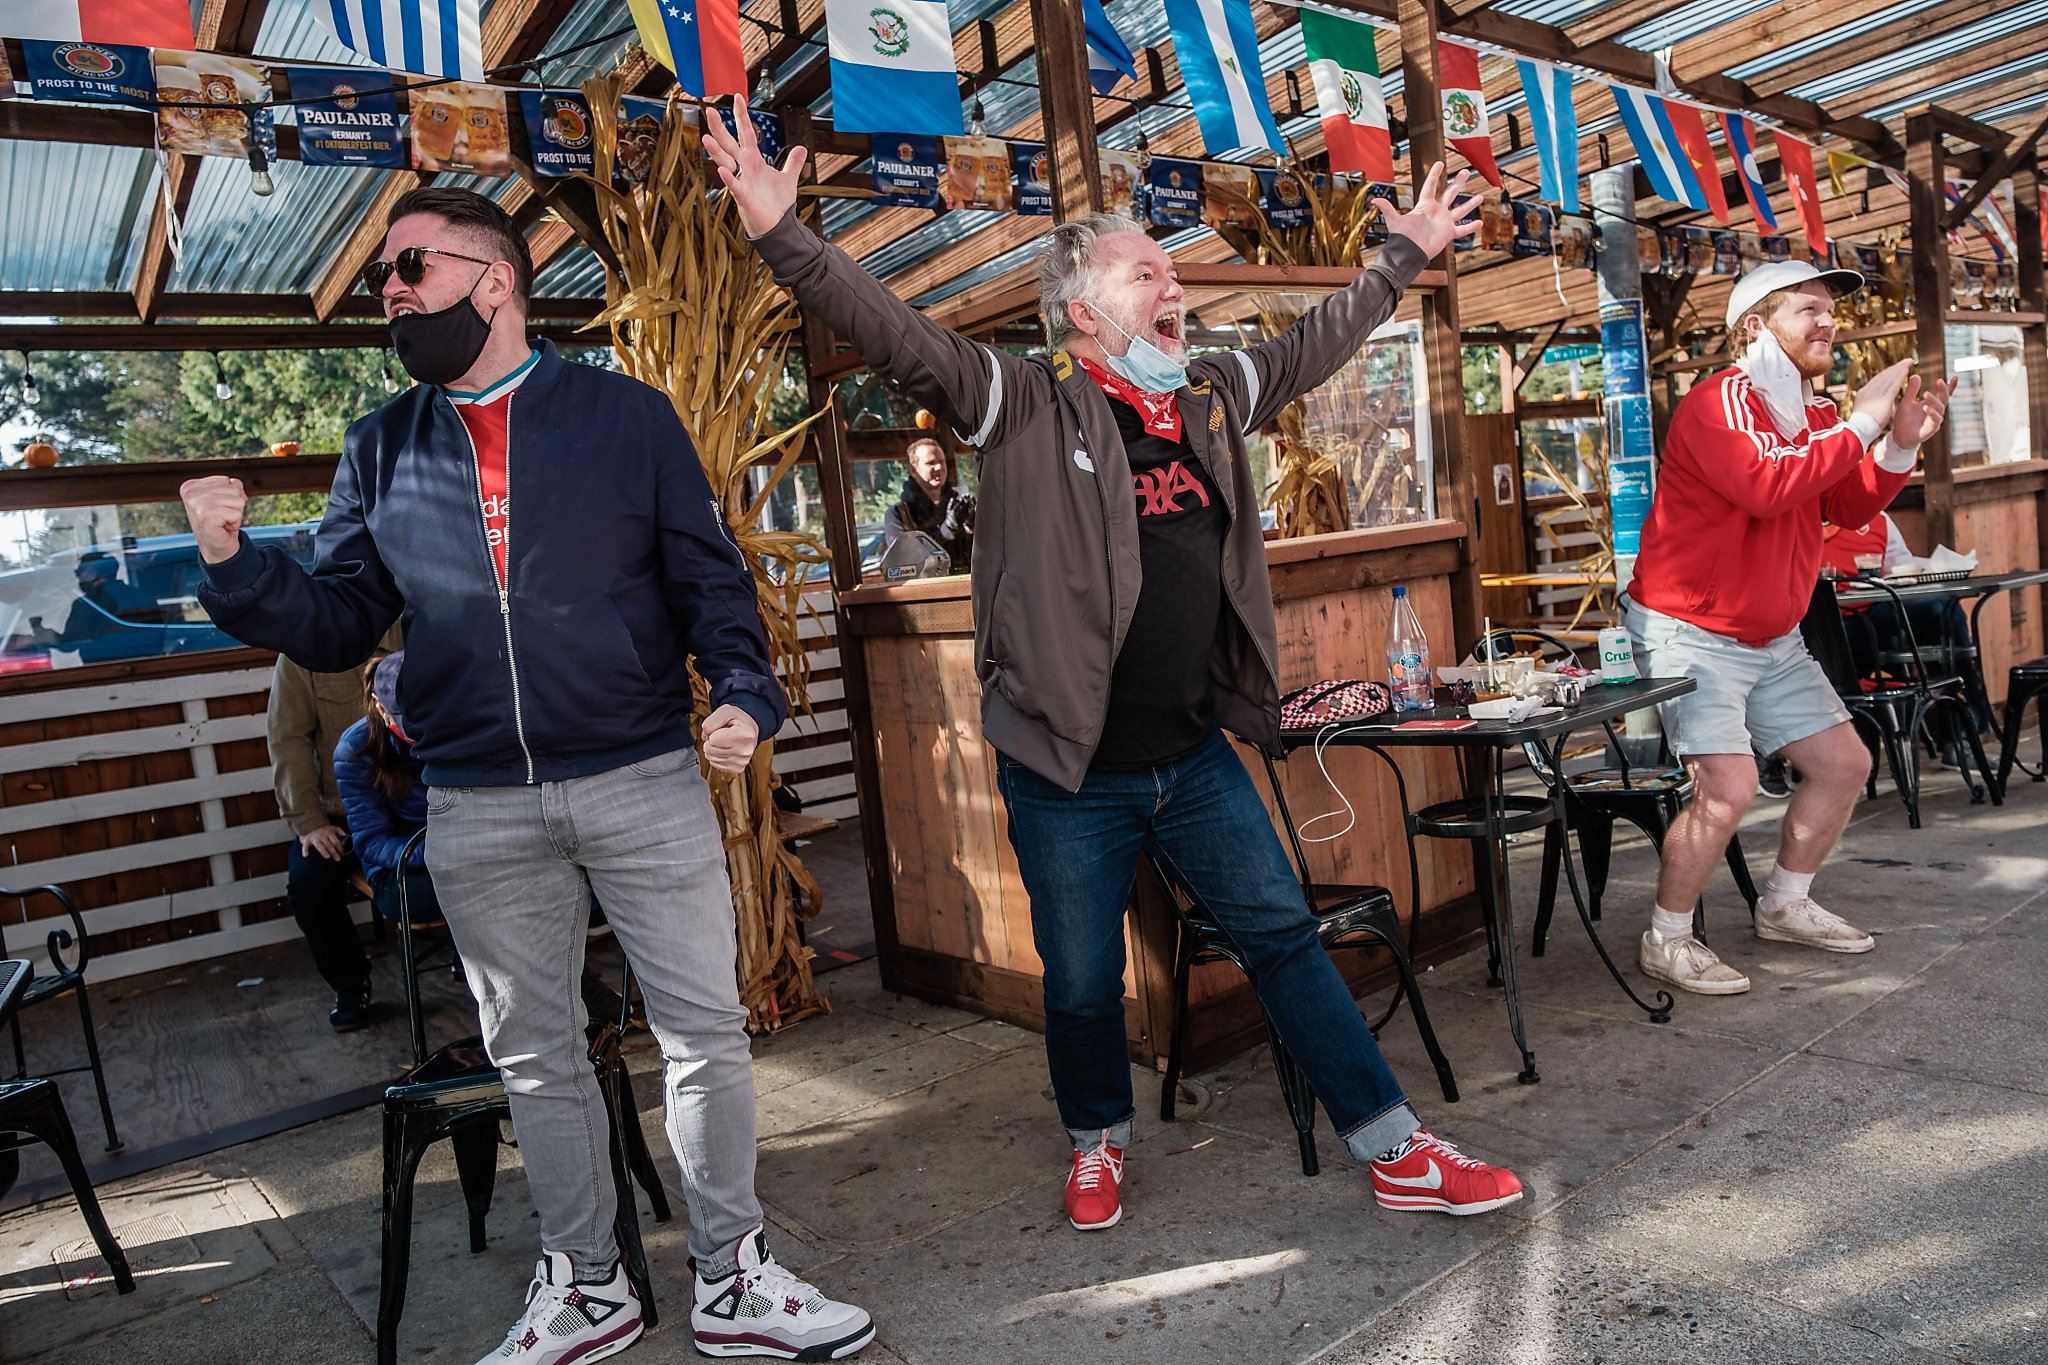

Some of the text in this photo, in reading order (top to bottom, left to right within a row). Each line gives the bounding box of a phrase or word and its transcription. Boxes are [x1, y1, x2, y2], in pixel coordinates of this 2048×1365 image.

[57, 43, 118, 61] PAULANER
[37, 79, 75, 88] PROST
[77, 80, 93, 89] TO
[95, 82, 118, 93] THE
[120, 86, 150, 100] MOST
[302, 109, 395, 127] PAULANER
[331, 130, 372, 141] GERMANY'S
[325, 140, 372, 150] OKTOBERFEST
[537, 152, 593, 165] PROST TO THE
[877, 161, 936, 178] PAULANER
[1154, 186, 1198, 201] PAULANER
[1605, 650, 1632, 662] Crus
